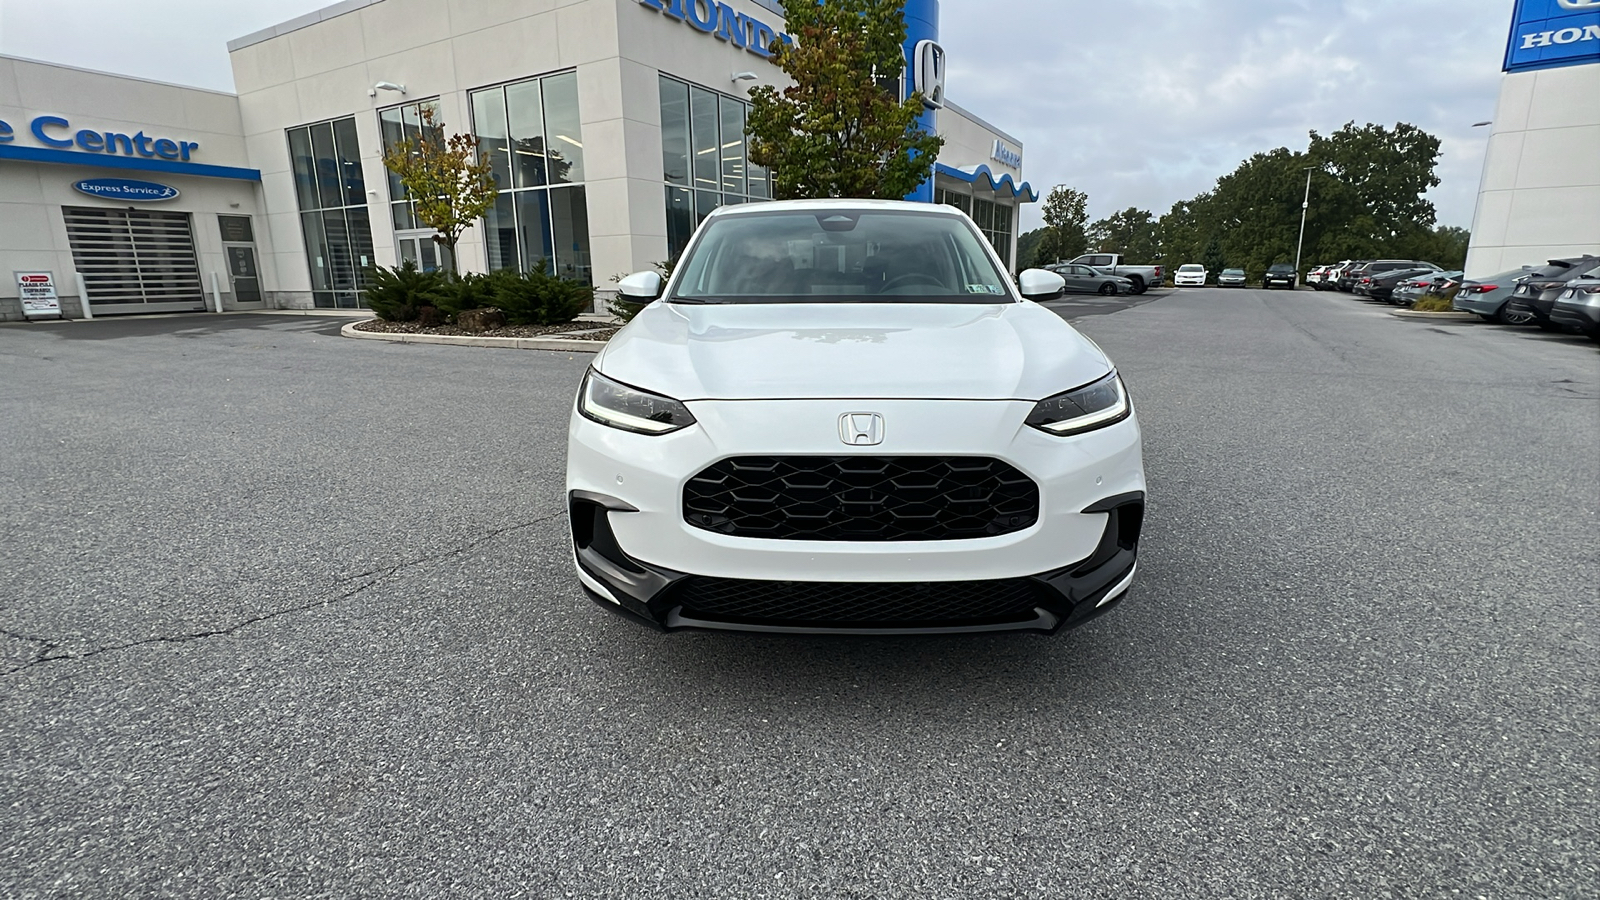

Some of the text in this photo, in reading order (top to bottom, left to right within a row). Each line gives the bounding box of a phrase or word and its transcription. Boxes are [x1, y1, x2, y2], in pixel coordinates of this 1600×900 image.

[30, 115, 199, 161] Center
[80, 182, 160, 195] Express Service
